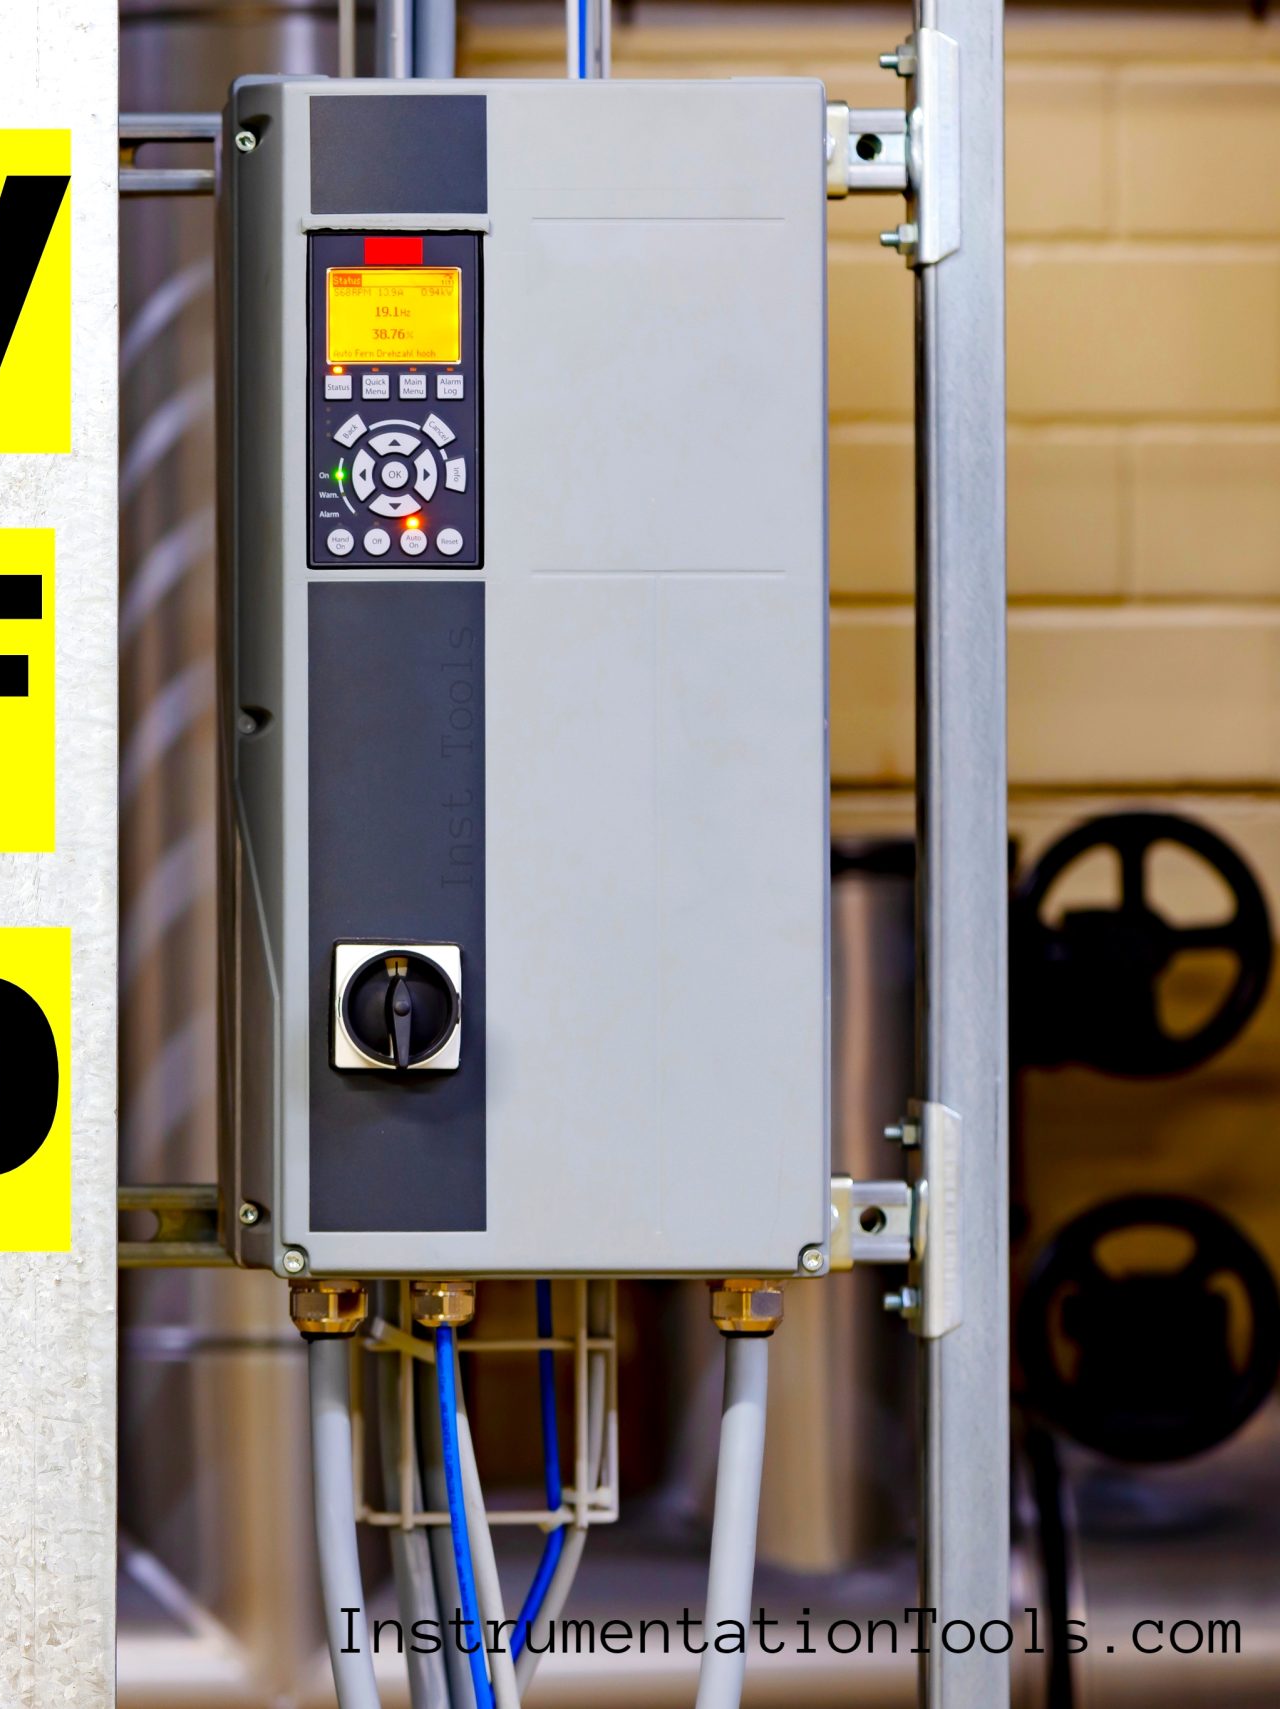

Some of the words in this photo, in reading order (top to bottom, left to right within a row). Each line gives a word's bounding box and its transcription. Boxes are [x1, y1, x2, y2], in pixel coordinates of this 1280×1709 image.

[333, 275, 361, 285] Status
[364, 378, 386, 386] Quick
[440, 378, 462, 386] Alarm
[327, 383, 350, 391] Status
[443, 387, 458, 396] Log
[342, 424, 358, 440] Back
[428, 420, 449, 441] Cancel
[388, 470, 402, 479] OK
[319, 510, 339, 518] Alarm
[406, 534, 422, 542] Auto
